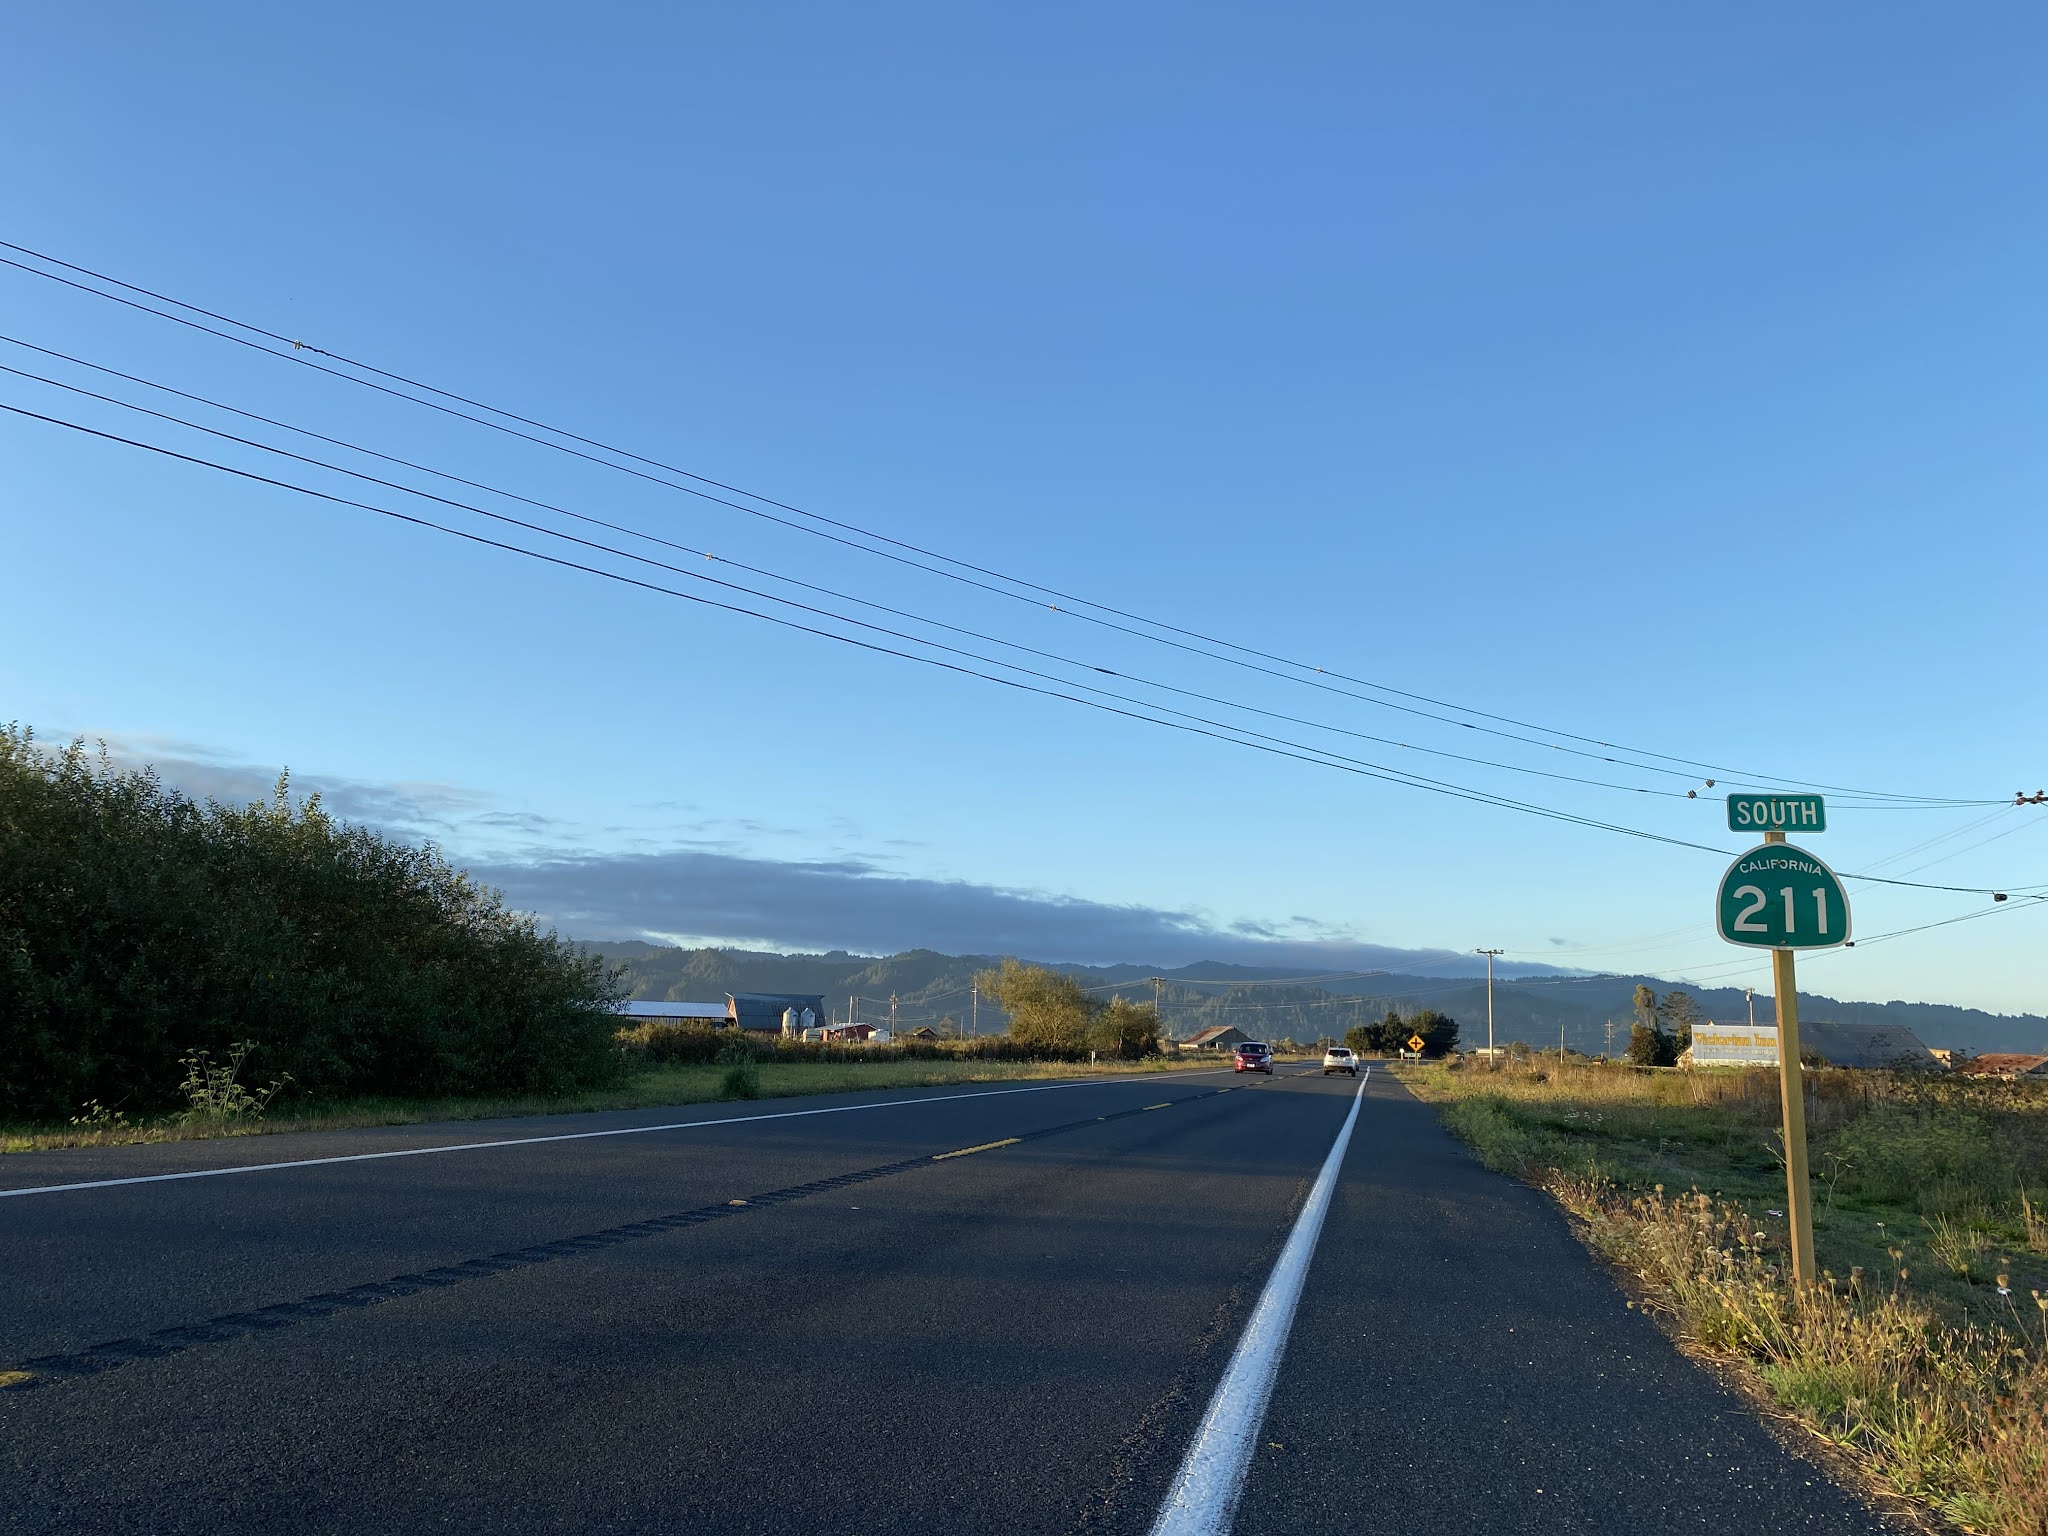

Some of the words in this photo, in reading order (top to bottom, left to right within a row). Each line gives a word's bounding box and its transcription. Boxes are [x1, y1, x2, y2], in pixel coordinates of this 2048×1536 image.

[1737, 801, 1817, 825] SOUTH
[1739, 859, 1822, 876] CALIFORNIA
[1733, 885, 1828, 934] 211
[1694, 1032, 1752, 1046] Victorian
[1754, 1034, 1777, 1047] Inn
